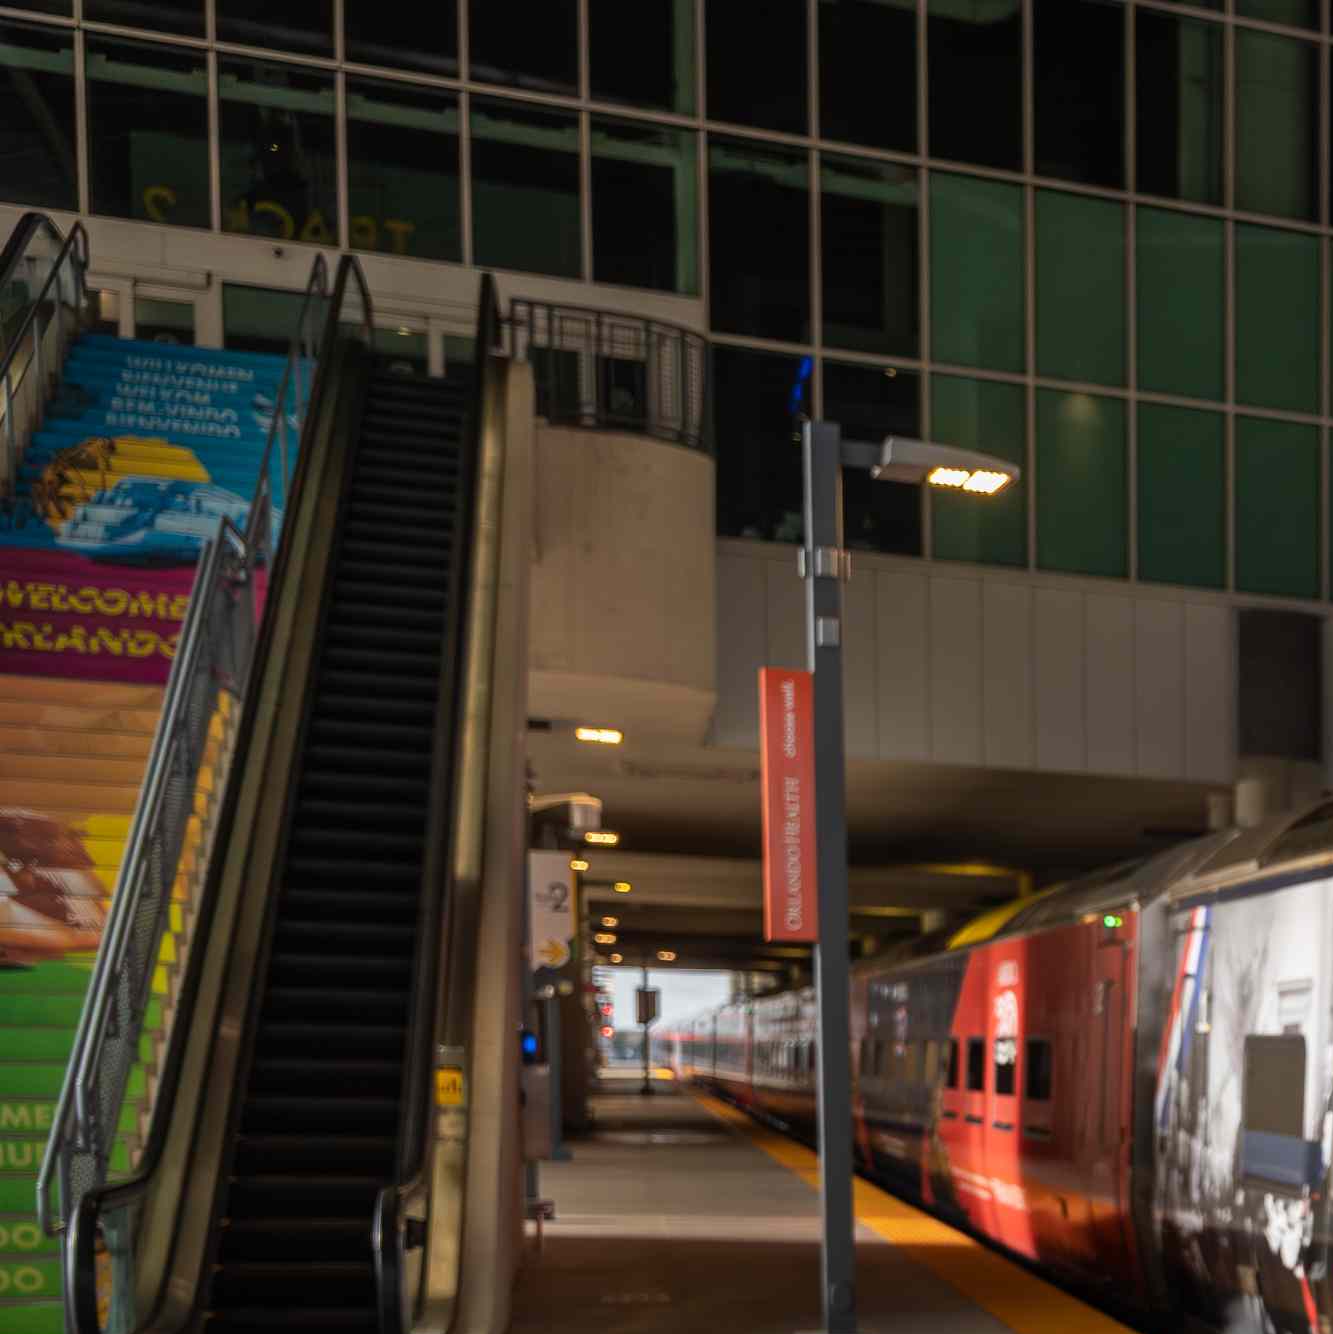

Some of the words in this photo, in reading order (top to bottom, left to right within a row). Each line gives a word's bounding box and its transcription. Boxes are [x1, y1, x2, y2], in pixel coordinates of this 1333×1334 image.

[0, 620, 181, 659] RLANDO
[784, 776, 800, 843] HEALTH
[783, 845, 801, 931] ORLANDO
